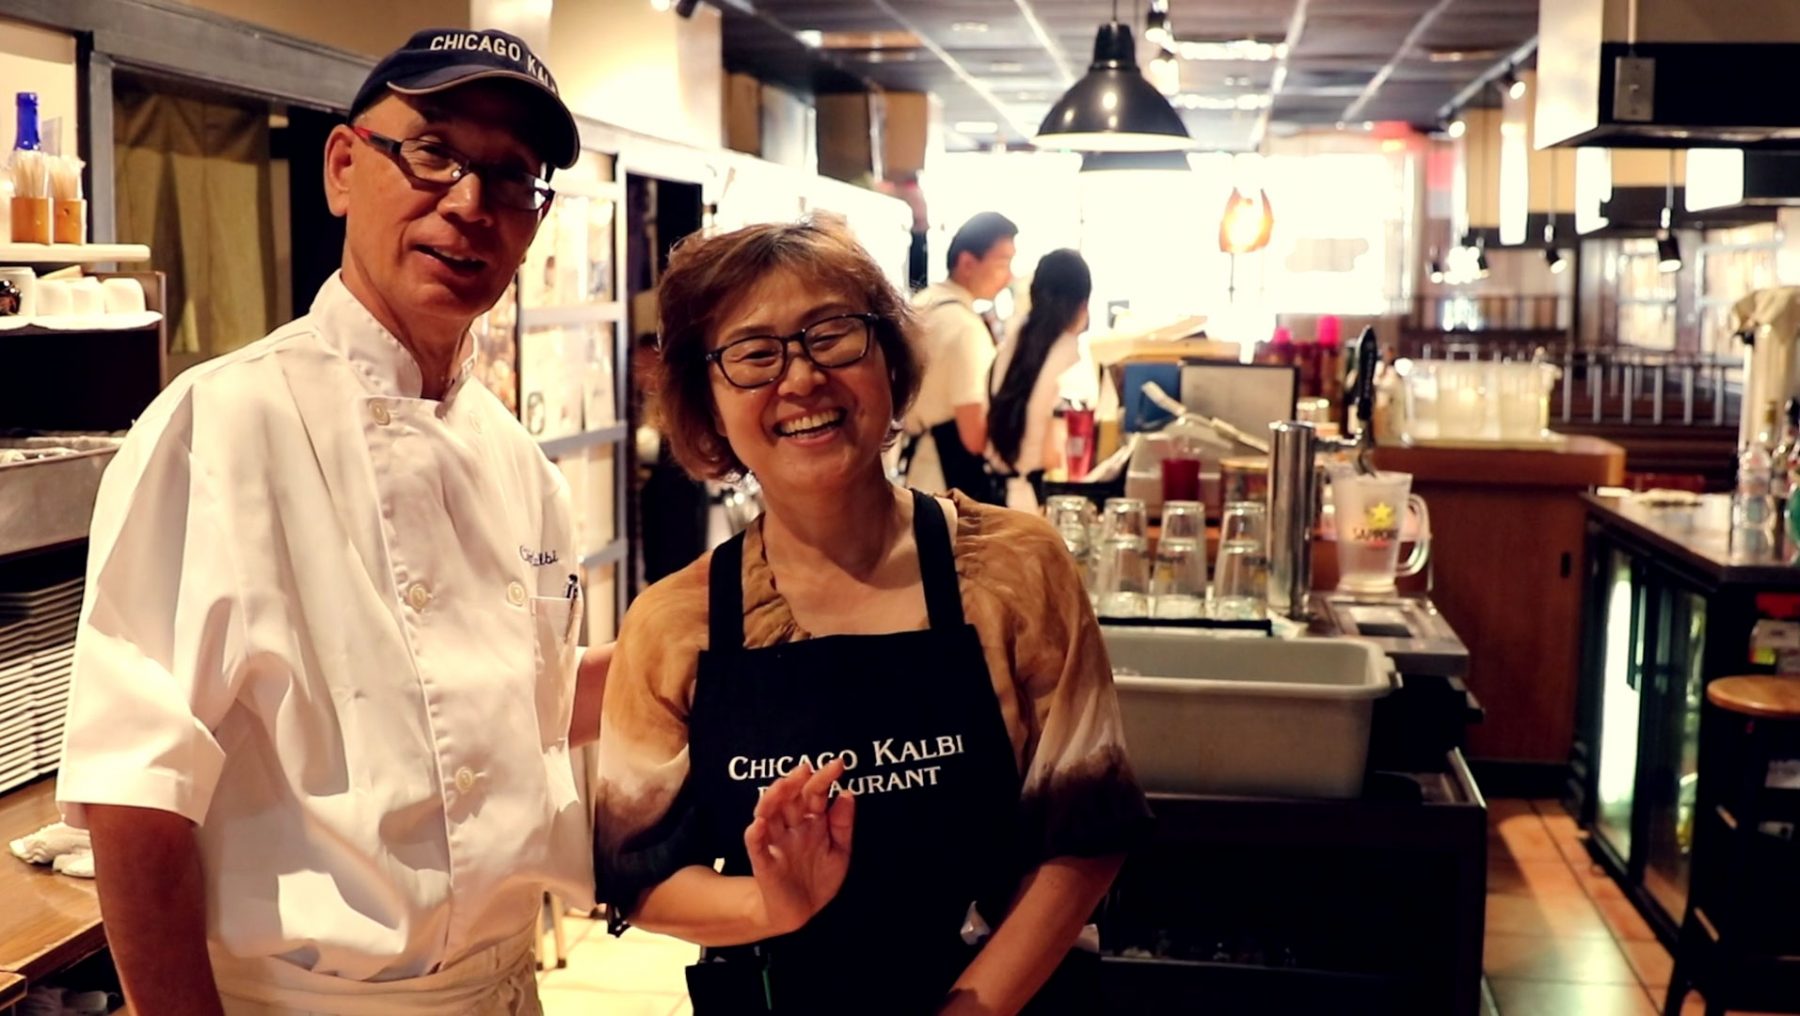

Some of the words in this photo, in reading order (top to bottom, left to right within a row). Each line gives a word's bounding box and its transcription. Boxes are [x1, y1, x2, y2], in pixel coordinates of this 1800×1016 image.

[430, 33, 521, 62] CHICAGO
[872, 734, 965, 767] KALBI
[757, 765, 942, 803] AURANT
